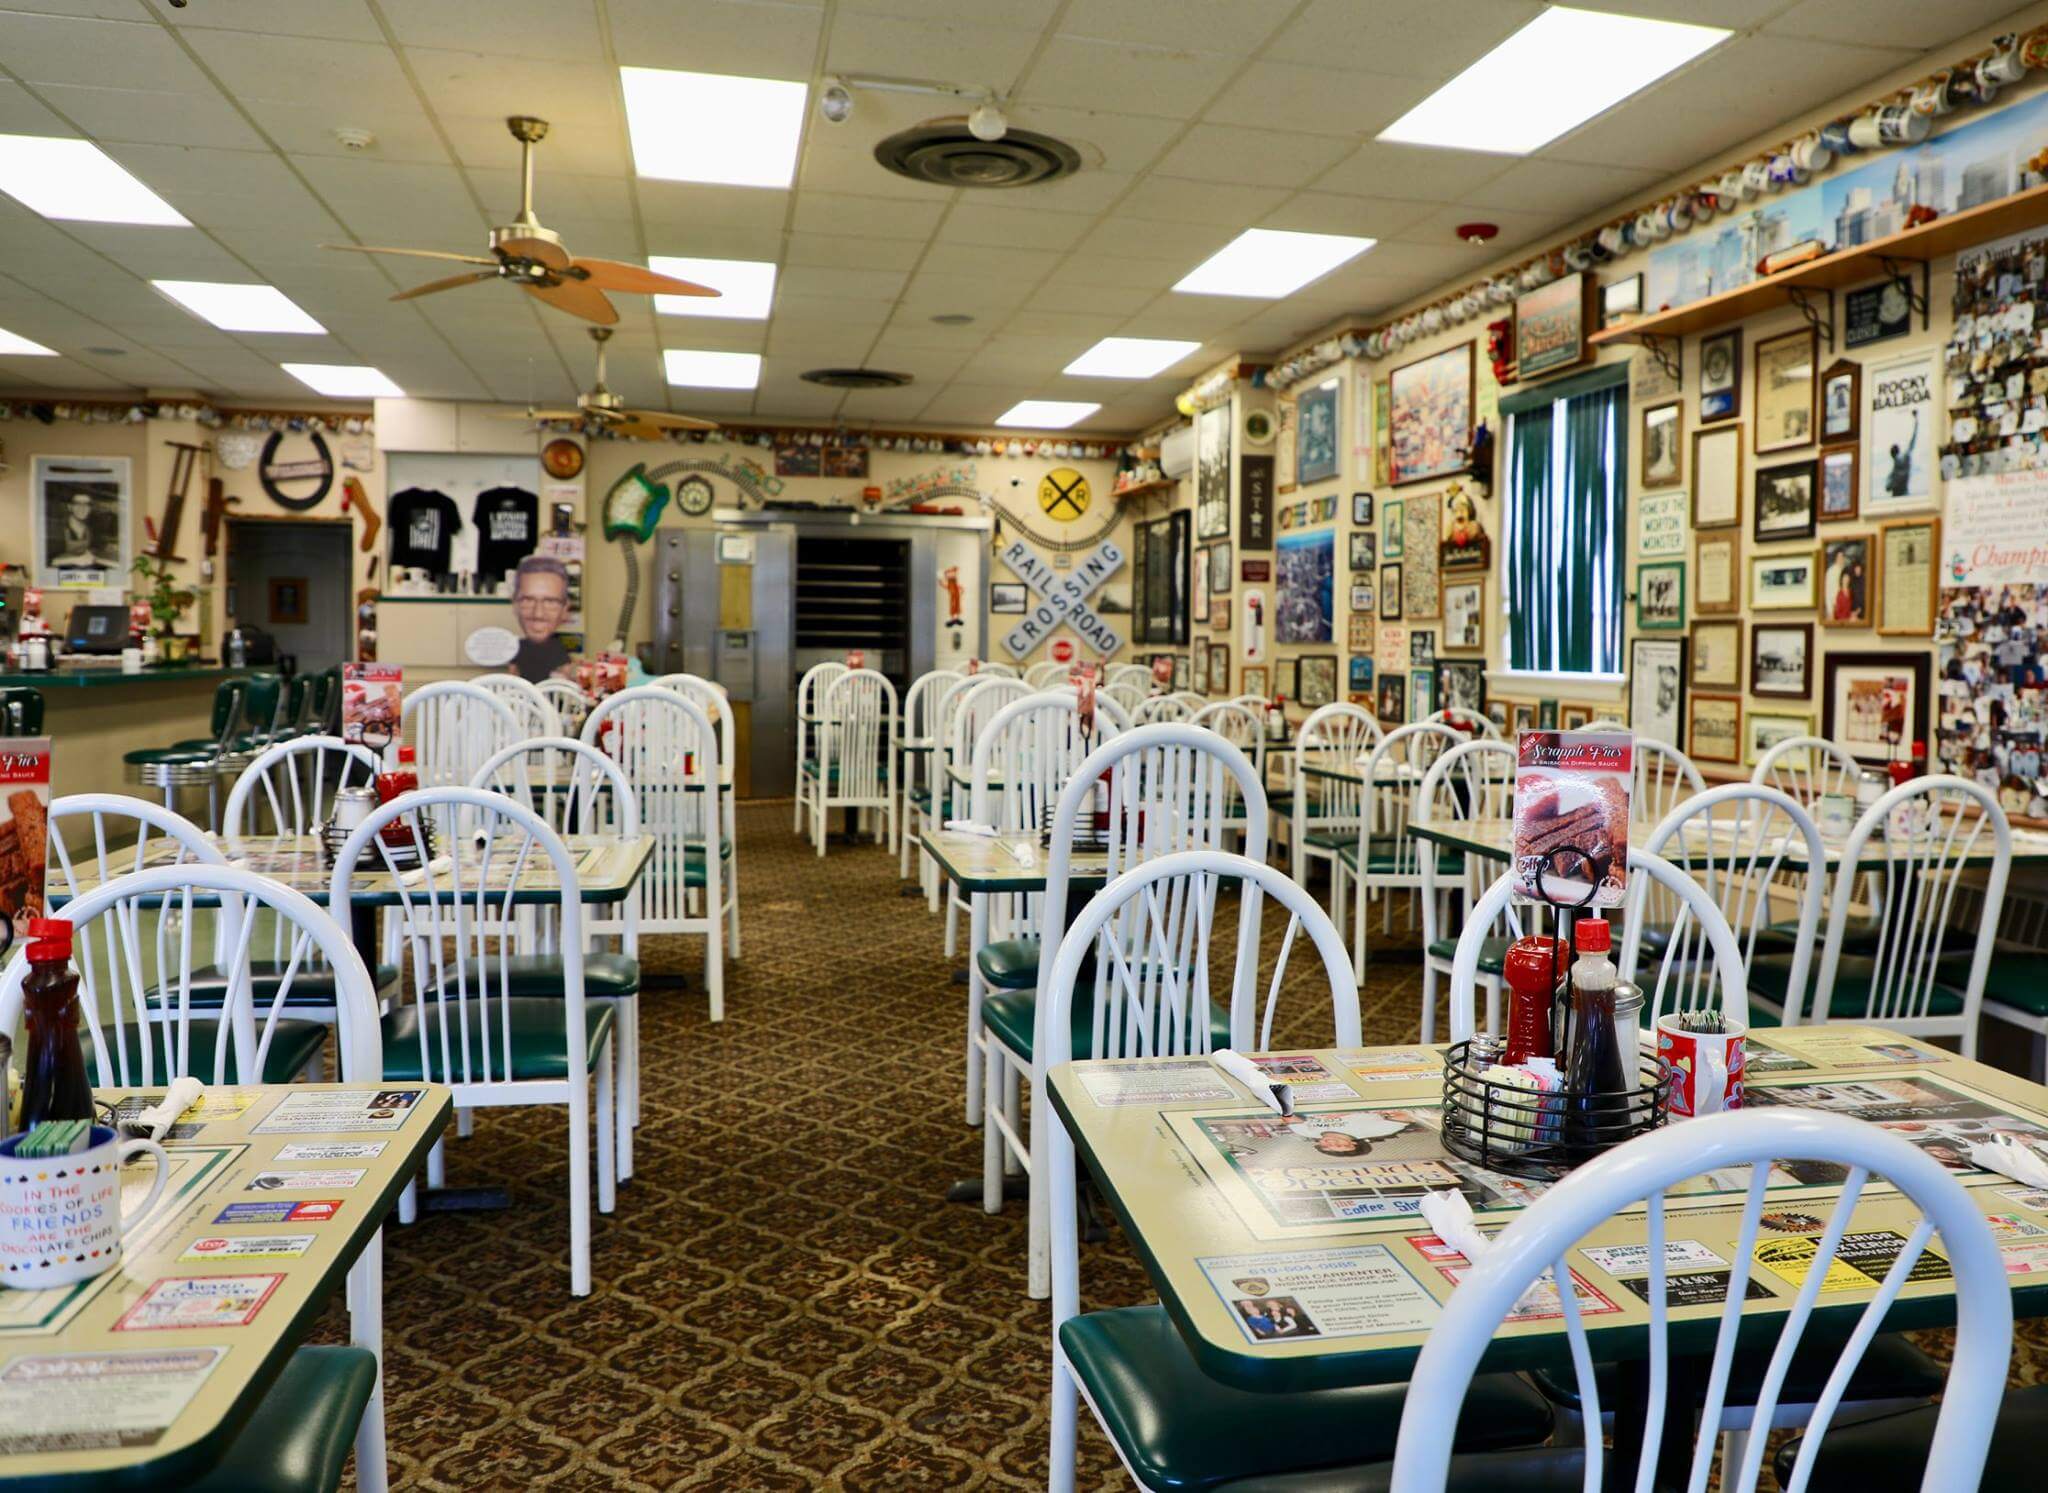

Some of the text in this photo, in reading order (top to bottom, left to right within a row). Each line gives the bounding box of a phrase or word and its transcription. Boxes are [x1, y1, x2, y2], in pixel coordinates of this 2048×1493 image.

[1878, 373, 1928, 395] ROCKY
[1872, 389, 1931, 412] BALBOA
[1076, 489, 1086, 501] R
[1521, 735, 1536, 751] NEW
[1533, 743, 1622, 760] Scrapple Fries
[1282, 1163, 1414, 1178] Grand
[1257, 1171, 1450, 1191] Opening
[24, 1184, 81, 1201] IN THE
[65, 1197, 84, 1210] OF
[90, 1185, 114, 1203] LIFE
[1333, 1199, 1354, 1208] the
[1342, 1202, 1385, 1216] Coffee
[11, 1204, 103, 1230] FRIENDS
[28, 1224, 92, 1242] ARE THE
[81, 1225, 113, 1246] CHIPS
[1837, 1238, 1908, 1254] XTERIOR
[1274, 1278, 1338, 1288] INSURANCE
[1276, 1268, 1393, 1283] LORI CARPENTER
[1692, 1275, 1718, 1284] SON
